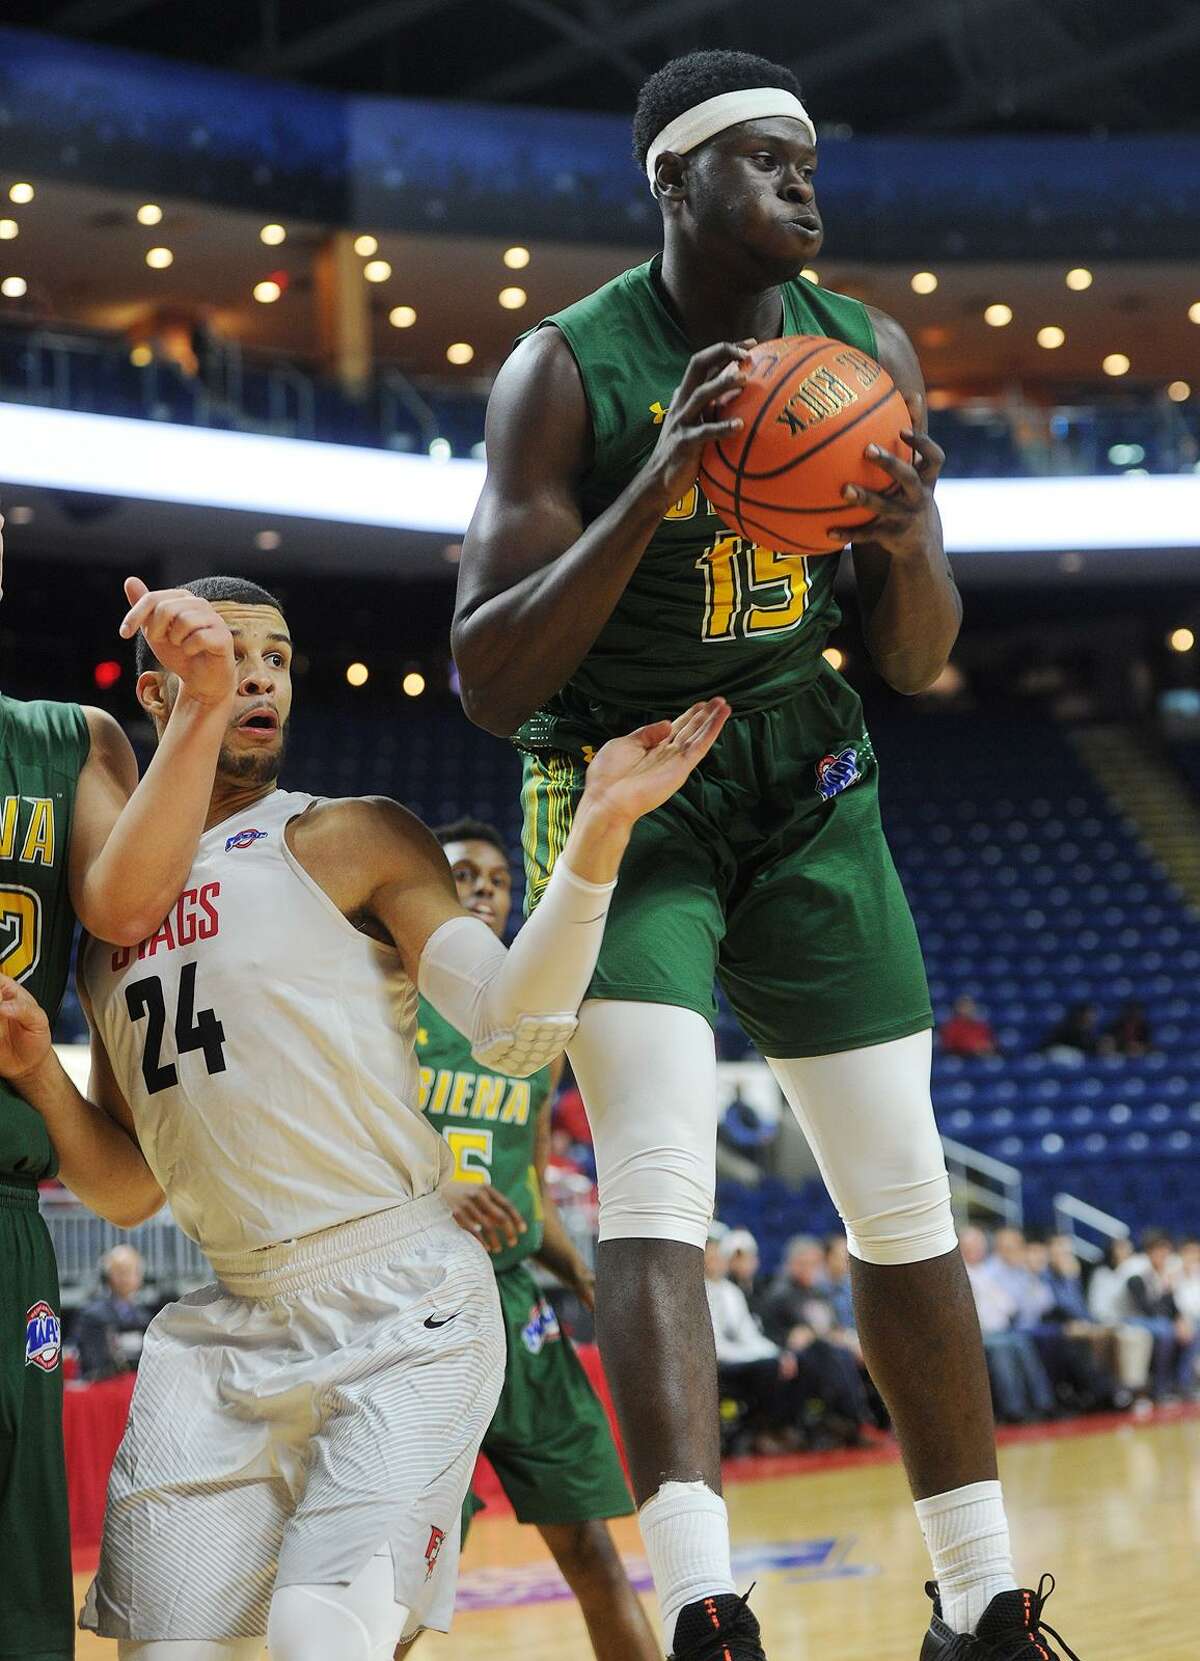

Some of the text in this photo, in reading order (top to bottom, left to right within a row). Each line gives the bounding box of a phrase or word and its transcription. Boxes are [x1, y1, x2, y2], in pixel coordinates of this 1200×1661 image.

[776, 366, 858, 437] ROCK
[695, 530, 813, 644] 15
[111, 881, 221, 973] AGS
[124, 960, 227, 1096] 24
[418, 1066, 531, 1126] SIENA
[442, 1126, 493, 1186] 5
